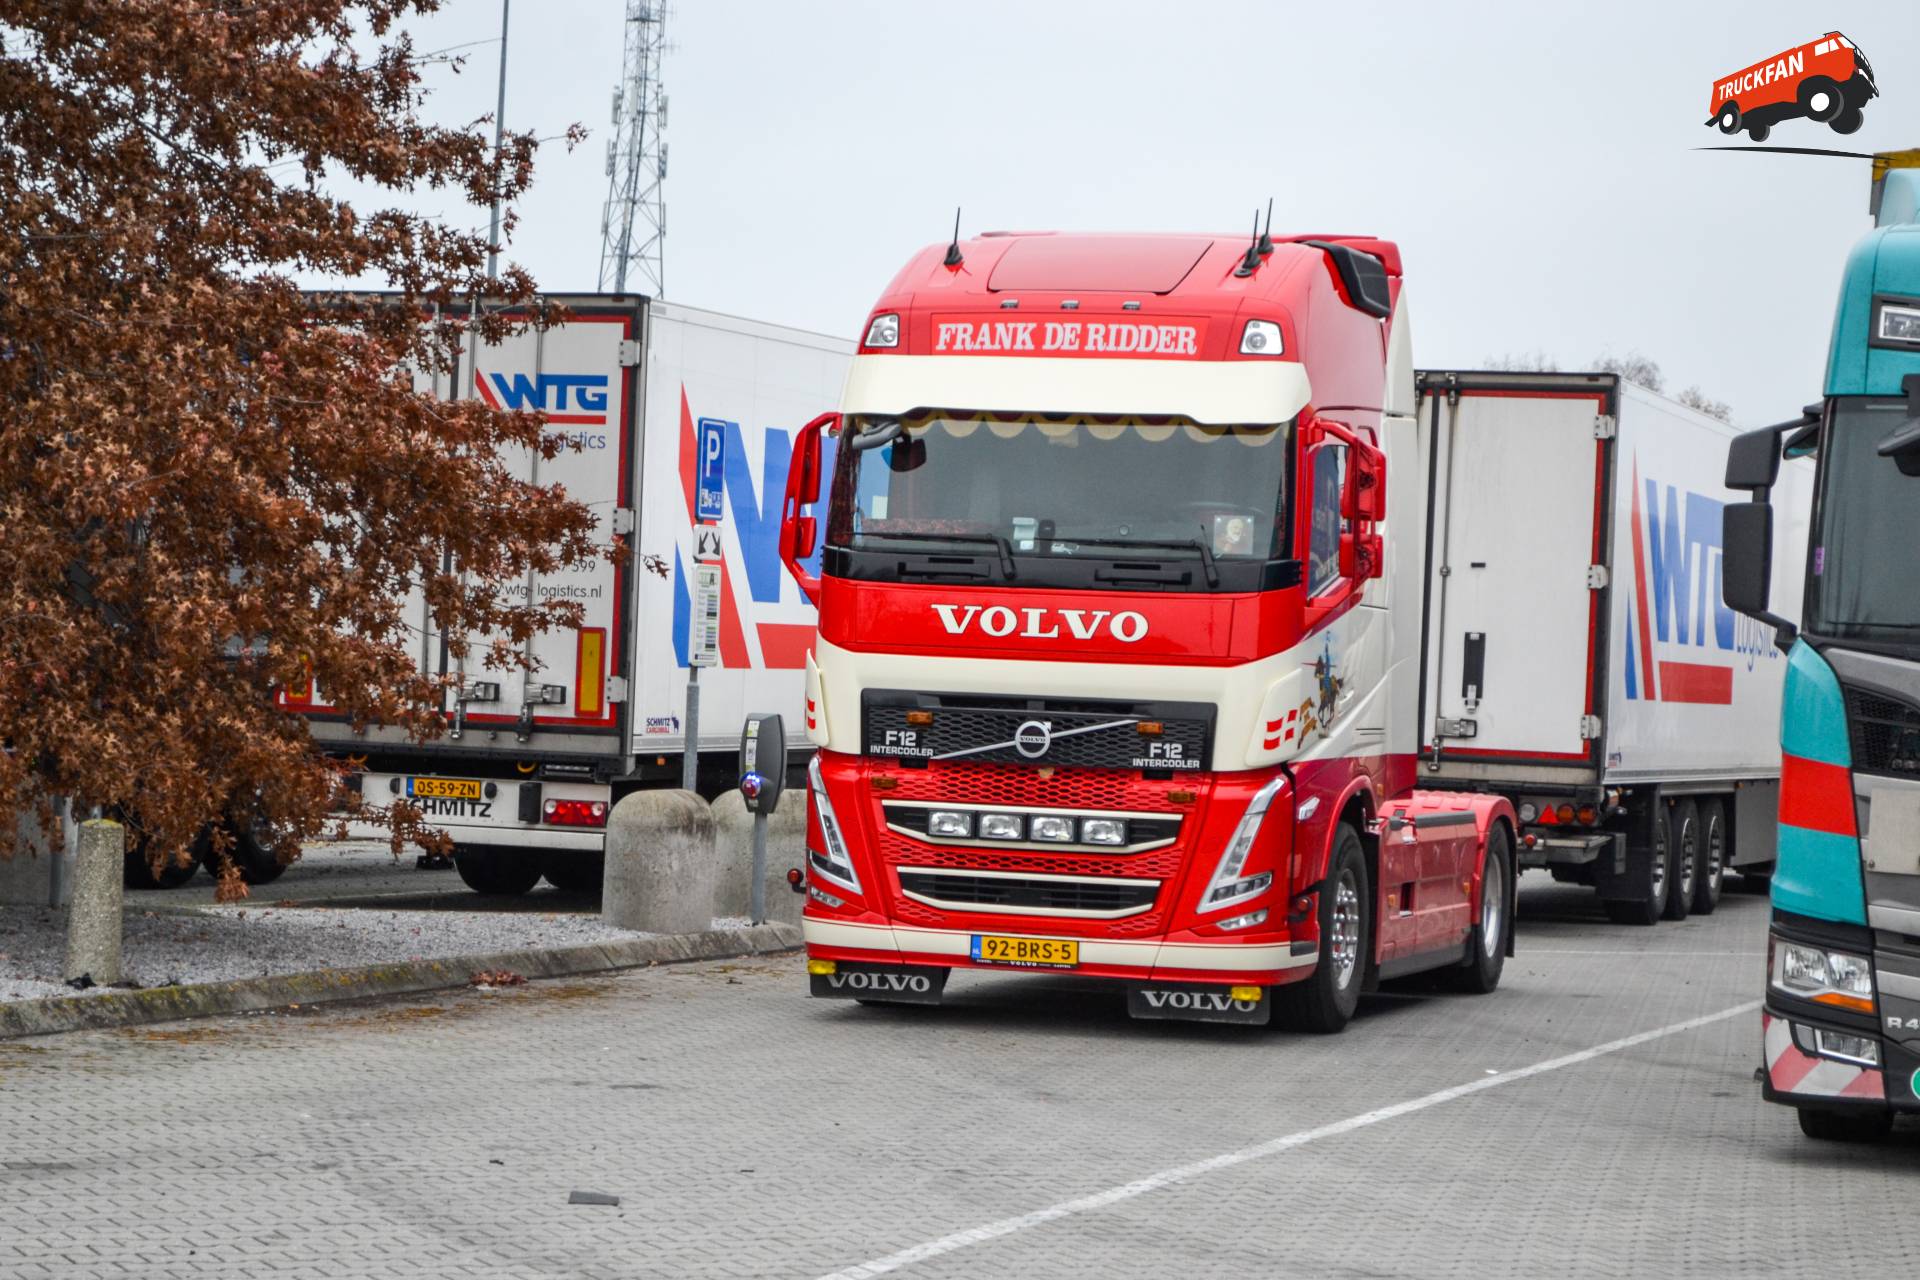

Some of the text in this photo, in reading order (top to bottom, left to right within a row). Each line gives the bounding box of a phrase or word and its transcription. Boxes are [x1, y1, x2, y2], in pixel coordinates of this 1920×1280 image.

[936, 323, 1197, 355] FRANK DE RIDDER
[490, 373, 608, 411] WTG
[706, 429, 720, 477] P
[931, 604, 1149, 642] VOLVO
[885, 731, 917, 746] F12
[870, 745, 934, 757] INTERCOOLER
[1150, 743, 1182, 758] F12
[1133, 758, 1200, 768] INTERCOOLER
[987, 940, 1071, 960] 92-BRS-5
[826, 972, 930, 992] VOLVO
